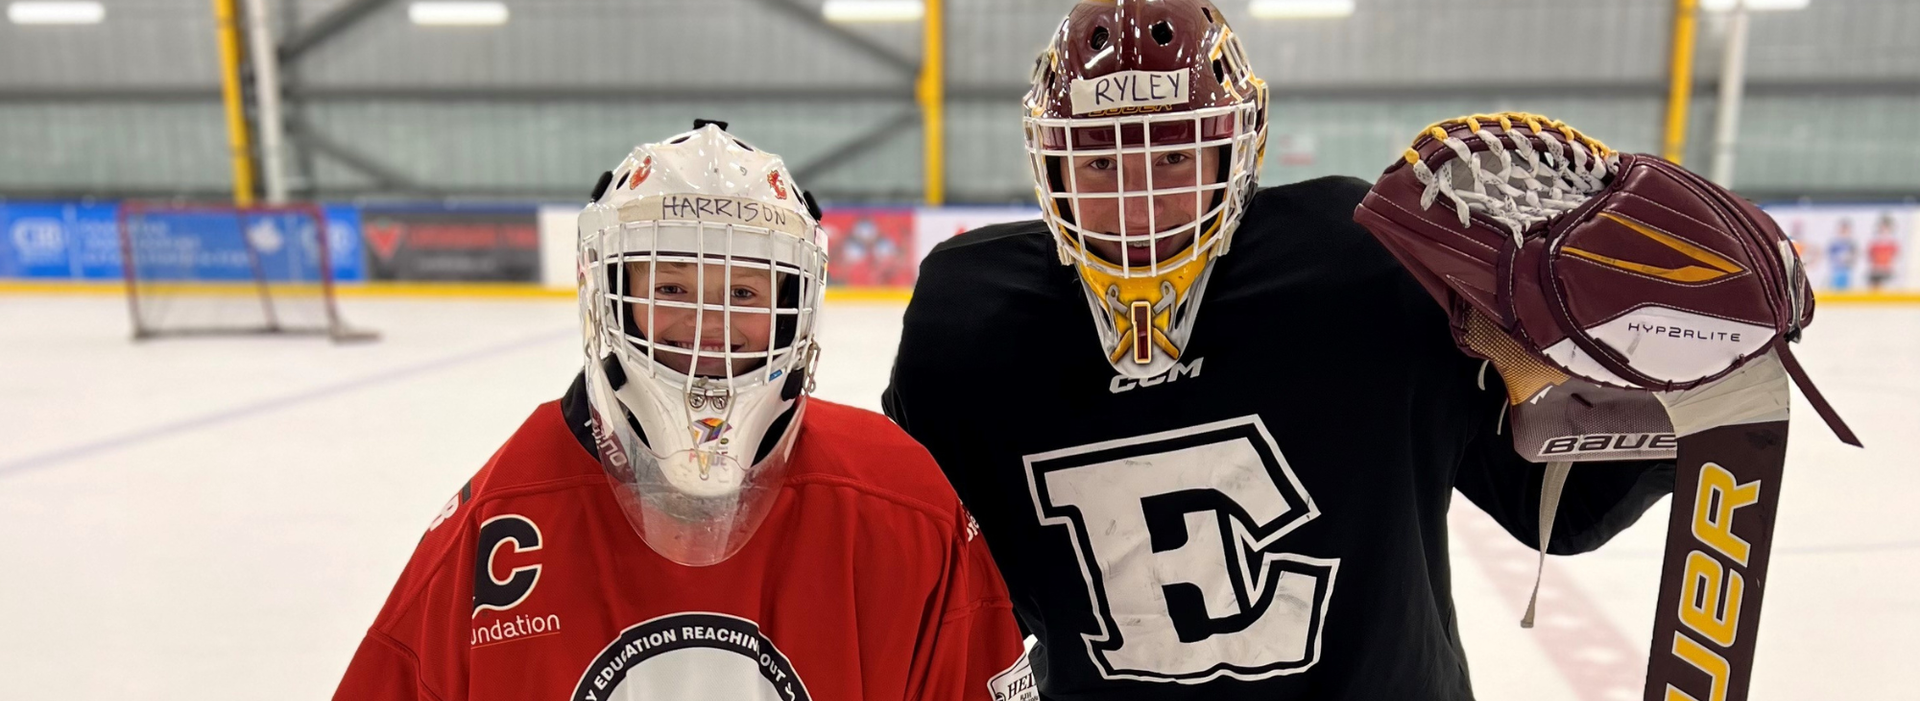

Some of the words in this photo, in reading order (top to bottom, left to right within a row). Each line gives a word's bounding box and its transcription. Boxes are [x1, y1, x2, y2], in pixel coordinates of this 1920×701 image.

[1095, 73, 1180, 106] RYLEY
[662, 196, 786, 226] HARRISON
[1627, 322, 1741, 343] HYP2RLITE
[1109, 356, 1205, 394] CCM
[1540, 434, 1678, 456] BAUE
[1022, 413, 1341, 685] E
[1665, 461, 1762, 701] UER
[471, 613, 561, 646] undation
[682, 626, 760, 656] REACHIN
[760, 653, 787, 682] OUT
